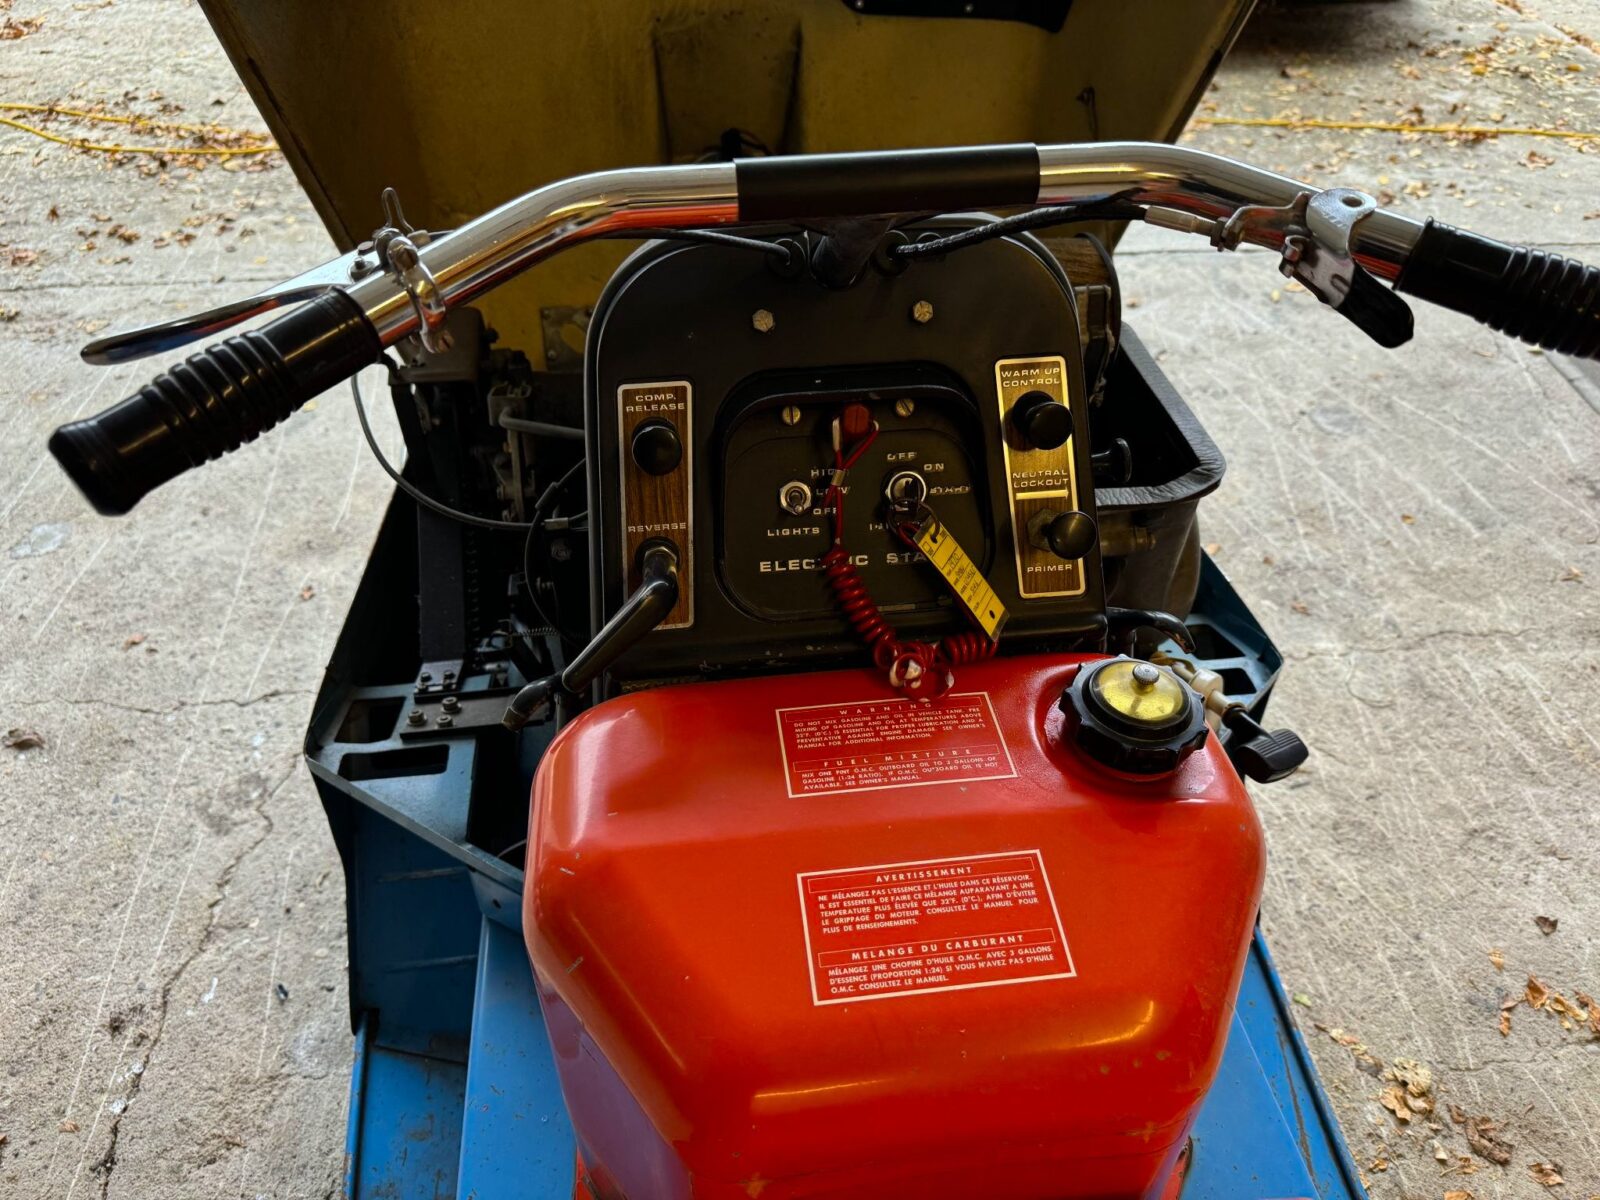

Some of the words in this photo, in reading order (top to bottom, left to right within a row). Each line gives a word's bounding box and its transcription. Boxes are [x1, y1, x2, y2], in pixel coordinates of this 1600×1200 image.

[1001, 367, 1041, 379] WARM
[1043, 366, 1061, 376] UP
[1002, 377, 1061, 388] CONTROL
[635, 393, 677, 402] COMP.
[625, 402, 686, 413] RELEASE
[924, 463, 945, 472] ON
[1012, 469, 1069, 479] NEUTRAL
[1013, 478, 1070, 488] LOCKOUT
[627, 522, 688, 533] REVERSE
[767, 527, 820, 537] LIGHTS
[759, 554, 869, 572] ELECIC
[886, 552, 928, 565] STA
[1026, 563, 1073, 573] PRIMER
[839, 702, 931, 715] WARNING
[910, 714, 957, 722] TEMPERATURES
[841, 726, 873, 734] ESSENTIAL
[917, 719, 959, 727] LUBRICATION
[796, 734, 841, 743] PREVENTATIVE
[846, 731, 874, 739] AGAINST
[796, 741, 825, 749] MANUAL
[844, 736, 883, 745] ADDITIONAL
[823, 757, 868, 767] FUEL
[884, 748, 970, 761] MIXTURE
[878, 762, 915, 771] OUTBOARD
[953, 756, 983, 764] GALLONS
[801, 775, 834, 784] GASOLINE
[875, 866, 971, 882] AVERTISSEMENT
[817, 893, 827, 901] NE
[870, 887, 886, 896] PAS
[886, 883, 921, 894] L'ESSENCE
[922, 882, 931, 890] ET
[932, 880, 958, 889] L'HUILE
[958, 877, 980, 887] DANS
[980, 876, 990, 885] CE
[827, 900, 840, 908] EST
[842, 897, 876, 906] ESSENTIEL
[879, 895, 889, 903] DE
[890, 893, 911, 901] FAIRE
[958, 883, 1009, 894] AUPARAVANT
[873, 903, 891, 912] PLUS
[921, 898, 937, 907] QUE
[985, 891, 1003, 900] AFIN
[833, 914, 869, 924] GRIPPAGE
[874, 912, 885, 920] DU
[925, 904, 967, 914] CONSULTEZ
[982, 899, 1013, 909] MANUEL
[1017, 896, 1039, 905] POUR
[822, 925, 840, 934] PLUS
[855, 917, 918, 930] RENSEIGNEMENTS.
[850, 946, 913, 960] MELANGE
[920, 943, 938, 952] DU
[944, 934, 1024, 949] CARBURANT
[871, 962, 887, 971] UNE
[889, 958, 923, 969] CHOPINE
[925, 955, 954, 965] D'HUILE
[985, 949, 1006, 959] AVEC
[1016, 944, 1052, 955] GALLONS
[828, 973, 867, 984] D'ESSENCE
[869, 967, 921, 980] (PROPORTION
[954, 961, 976, 971] VOUS
[977, 958, 1007, 968] N'AVEZ
[1007, 956, 1024, 965] PAS
[1025, 953, 1054, 963] D'HUILE
[858, 979, 901, 990] CONSULTEZ
[903, 977, 912, 985] LE
